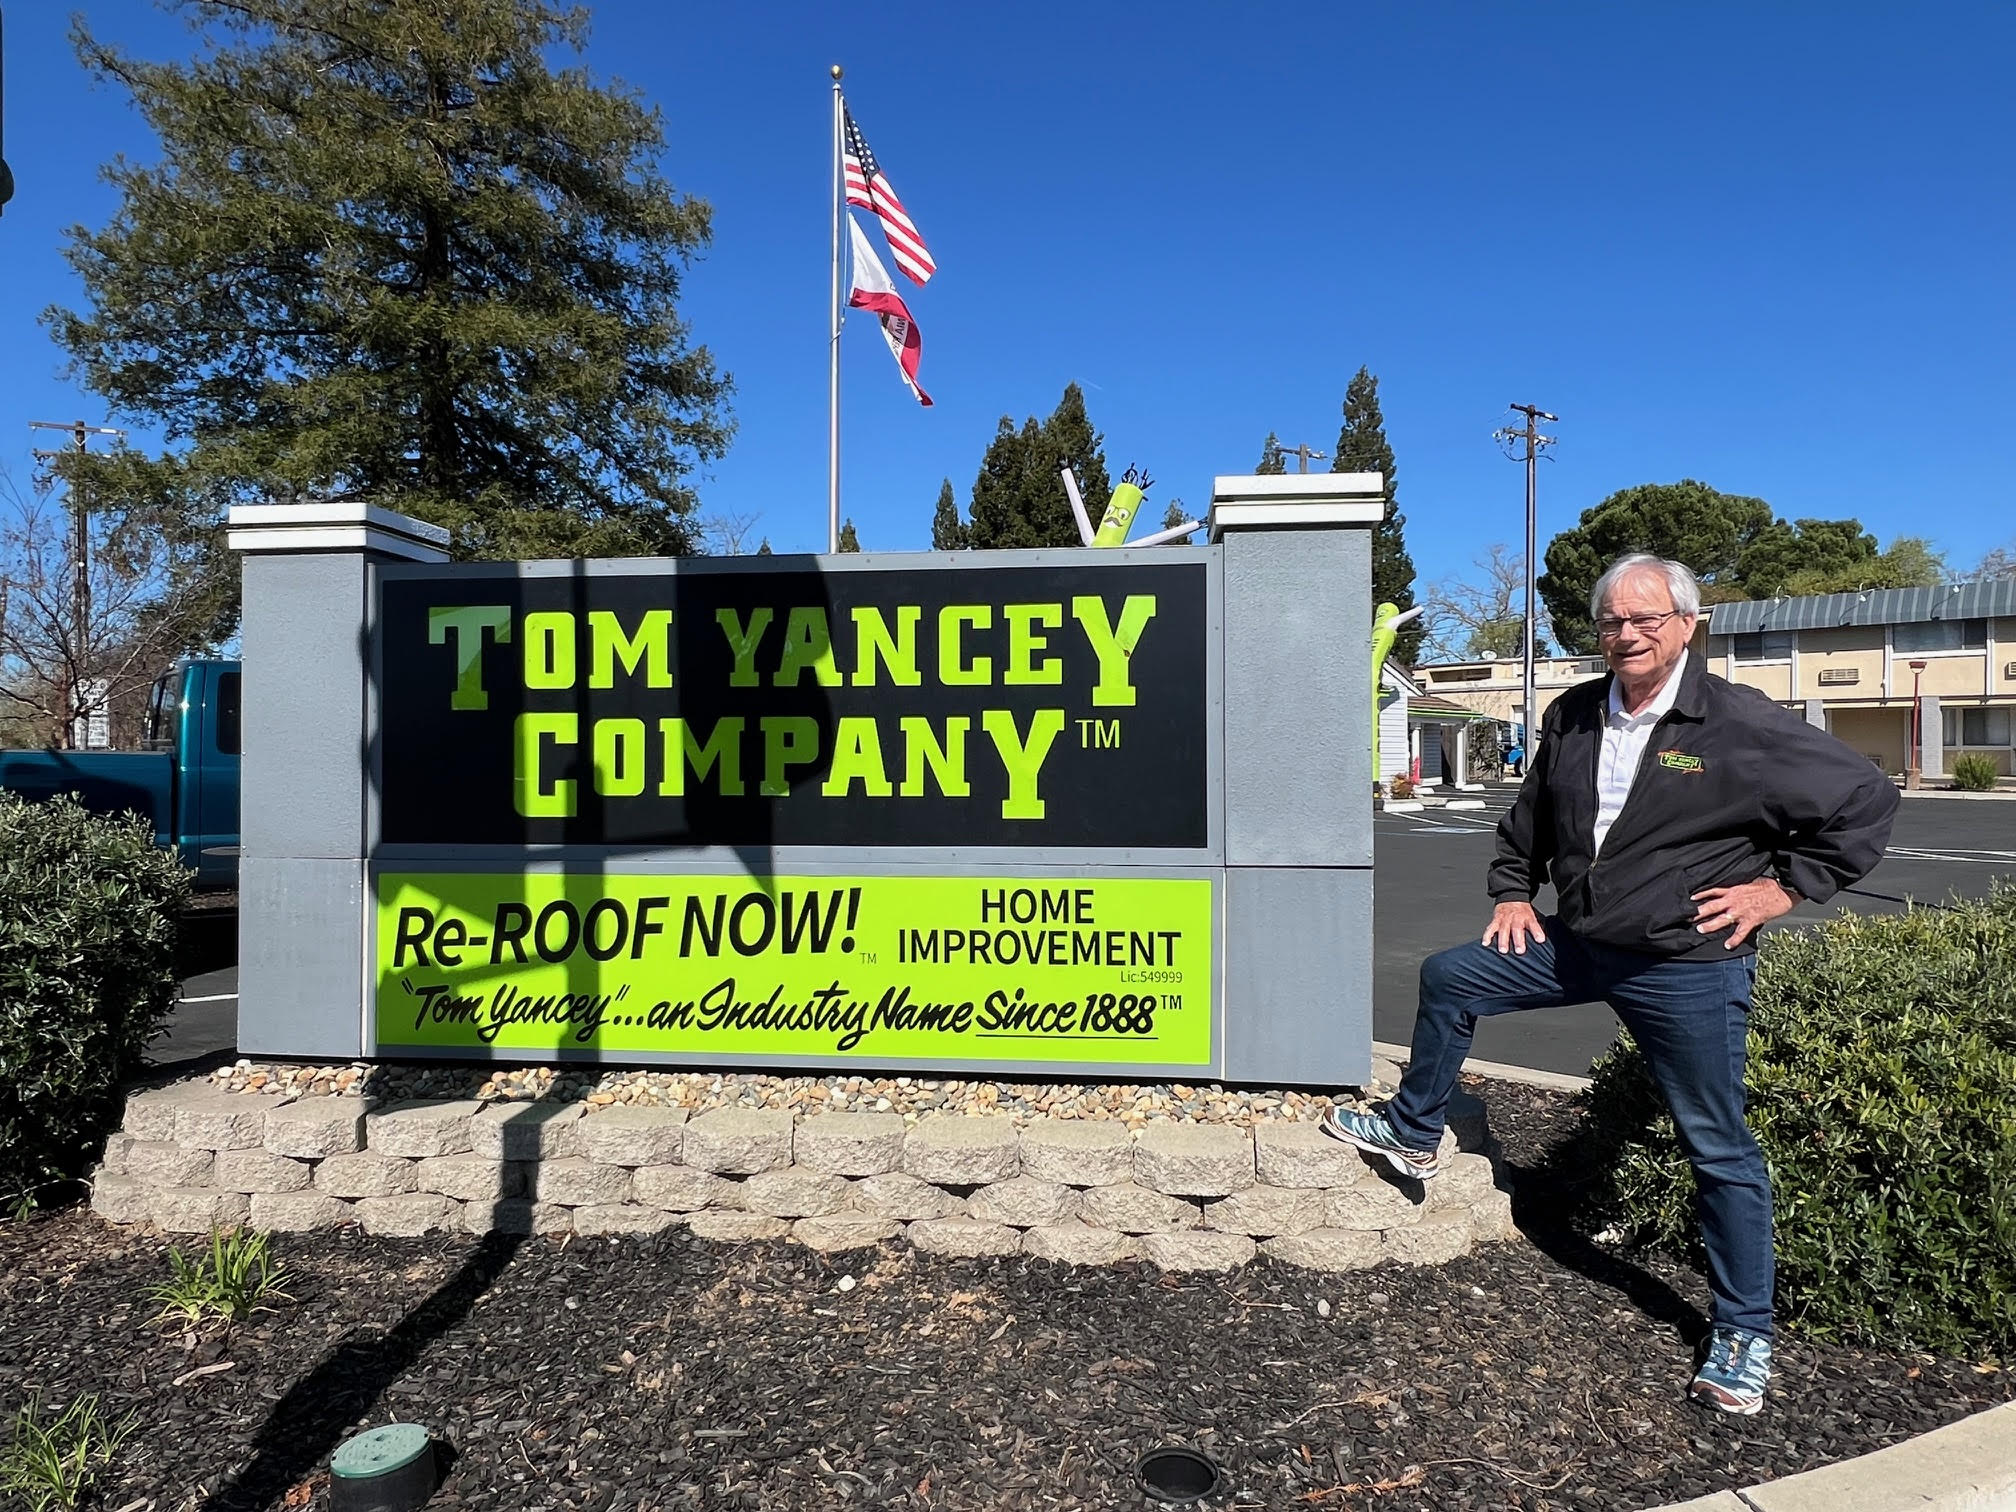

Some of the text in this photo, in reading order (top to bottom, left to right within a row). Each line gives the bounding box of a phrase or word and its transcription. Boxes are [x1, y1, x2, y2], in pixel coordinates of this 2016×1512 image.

[429, 595, 1156, 710] TOM YANCEY
[514, 710, 1120, 819] COMPANY TM
[393, 897, 670, 968] Re-ROOF
[679, 887, 862, 957] NOW!
[981, 888, 1095, 924] HOME
[898, 928, 1182, 967] IMPROVEMENT
[1120, 971, 1183, 984] Lic:549999
[696, 977, 870, 1052] Industry
[869, 985, 973, 1033] Name
[975, 986, 1077, 1034] Since
[1079, 993, 1157, 1034] 1888
